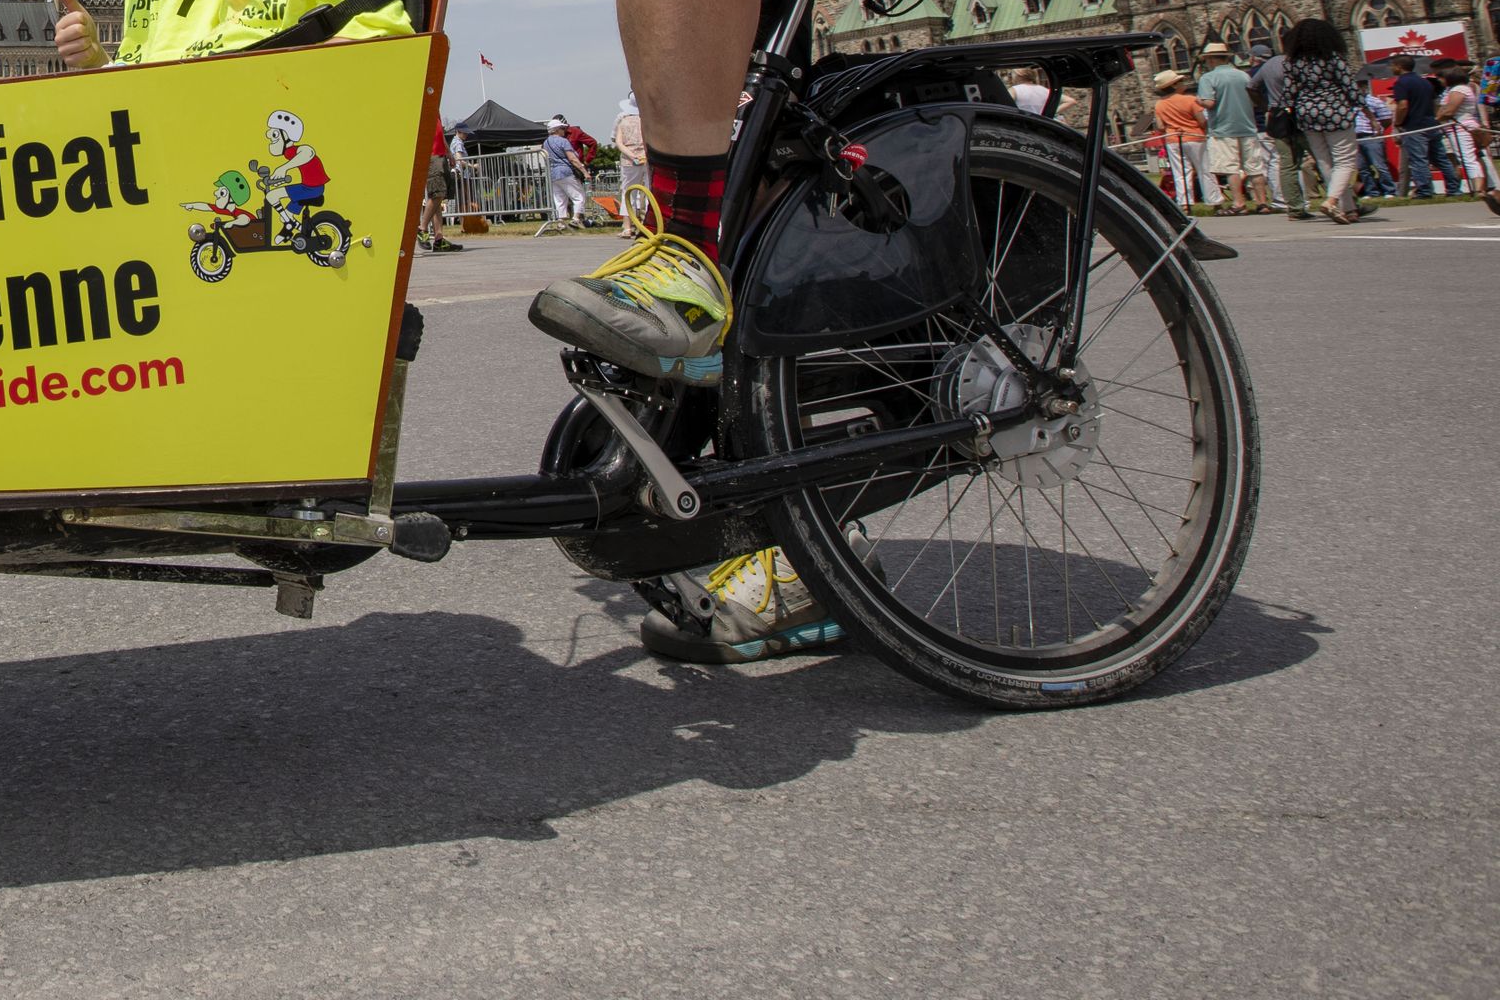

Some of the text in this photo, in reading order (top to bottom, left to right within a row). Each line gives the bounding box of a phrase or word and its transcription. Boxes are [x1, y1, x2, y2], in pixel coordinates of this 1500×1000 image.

[776, 146, 794, 156] AXA
[940, 656, 971, 674] PLUS
[975, 671, 1040, 690] MARATHON
